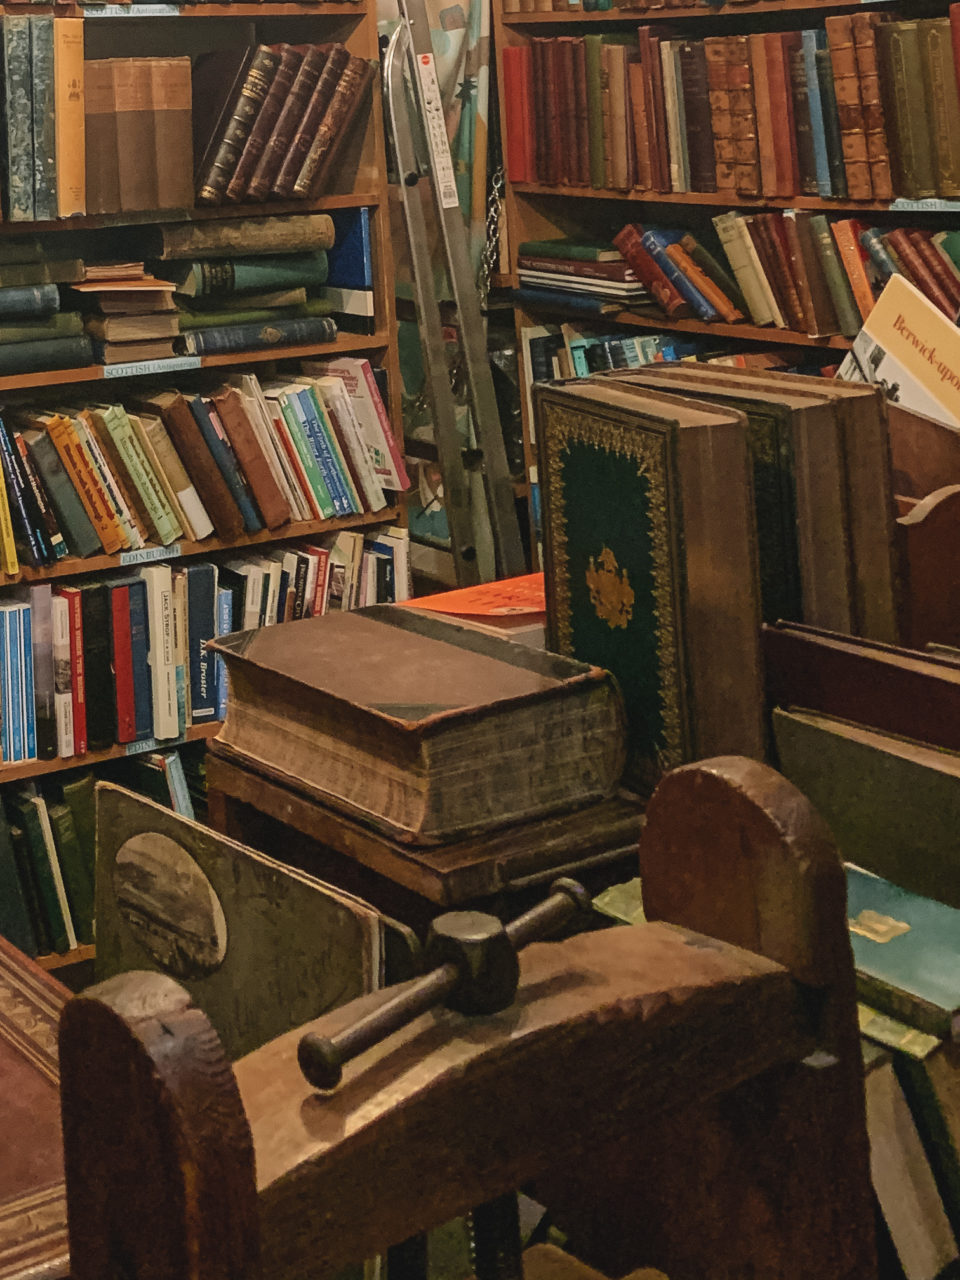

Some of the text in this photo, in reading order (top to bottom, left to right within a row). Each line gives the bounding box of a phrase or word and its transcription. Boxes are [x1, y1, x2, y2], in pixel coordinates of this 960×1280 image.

[892, 314, 960, 391] Berwick-upo
[105, 364, 151, 377] SCOTTISH
[122, 544, 179, 564] EDINBURGH
[199, 662, 208, 699] Broster
